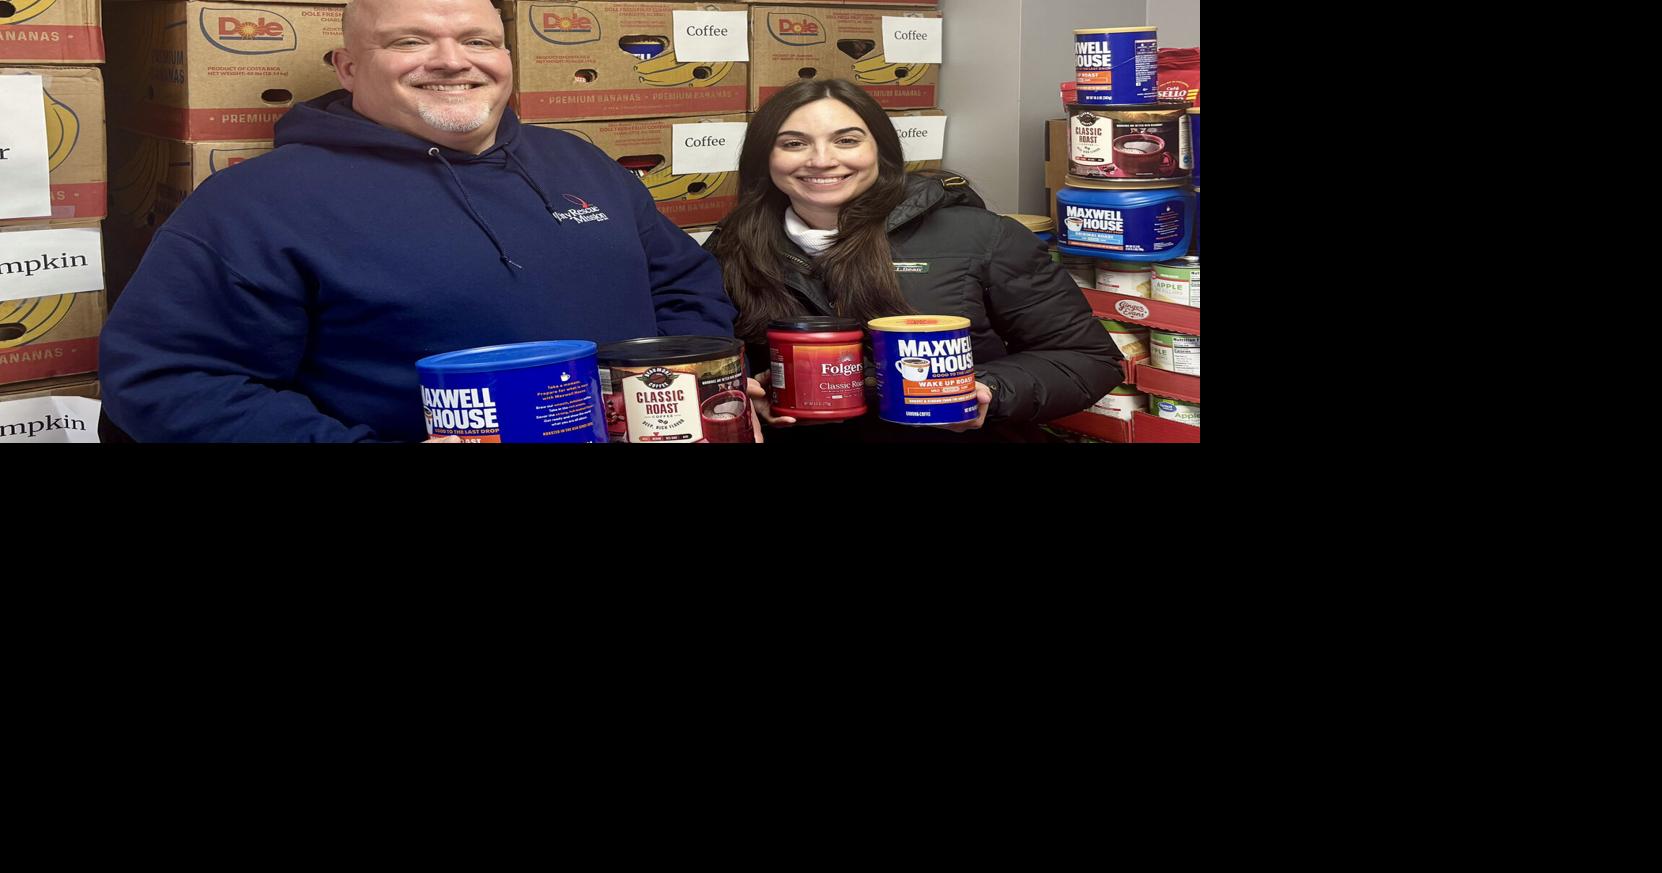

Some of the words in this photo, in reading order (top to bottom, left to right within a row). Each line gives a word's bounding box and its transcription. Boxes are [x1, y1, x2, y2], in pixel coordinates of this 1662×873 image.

[218, 16, 284, 38] Dole
[543, 12, 592, 30] Dole
[779, 18, 818, 33] Dole
[686, 25, 728, 37] Coffee
[894, 30, 928, 41] Coffee
[1077, 54, 1112, 68] OUSE
[549, 96, 595, 104] PREMIUM
[599, 94, 641, 102] BANANAS
[1076, 127, 1102, 136] CLASSIC
[684, 136, 726, 148] Coffee
[1066, 206, 1124, 221] MAXWELL
[1083, 218, 1124, 232] HOUSE
[1156, 282, 1184, 290] APPLE
[930, 352, 974, 374] HOUS
[636, 390, 684, 403] CLASSIC
[646, 403, 678, 415] ROAST
[432, 408, 499, 429] HOUSE
[0, 414, 86, 438] mpkin
